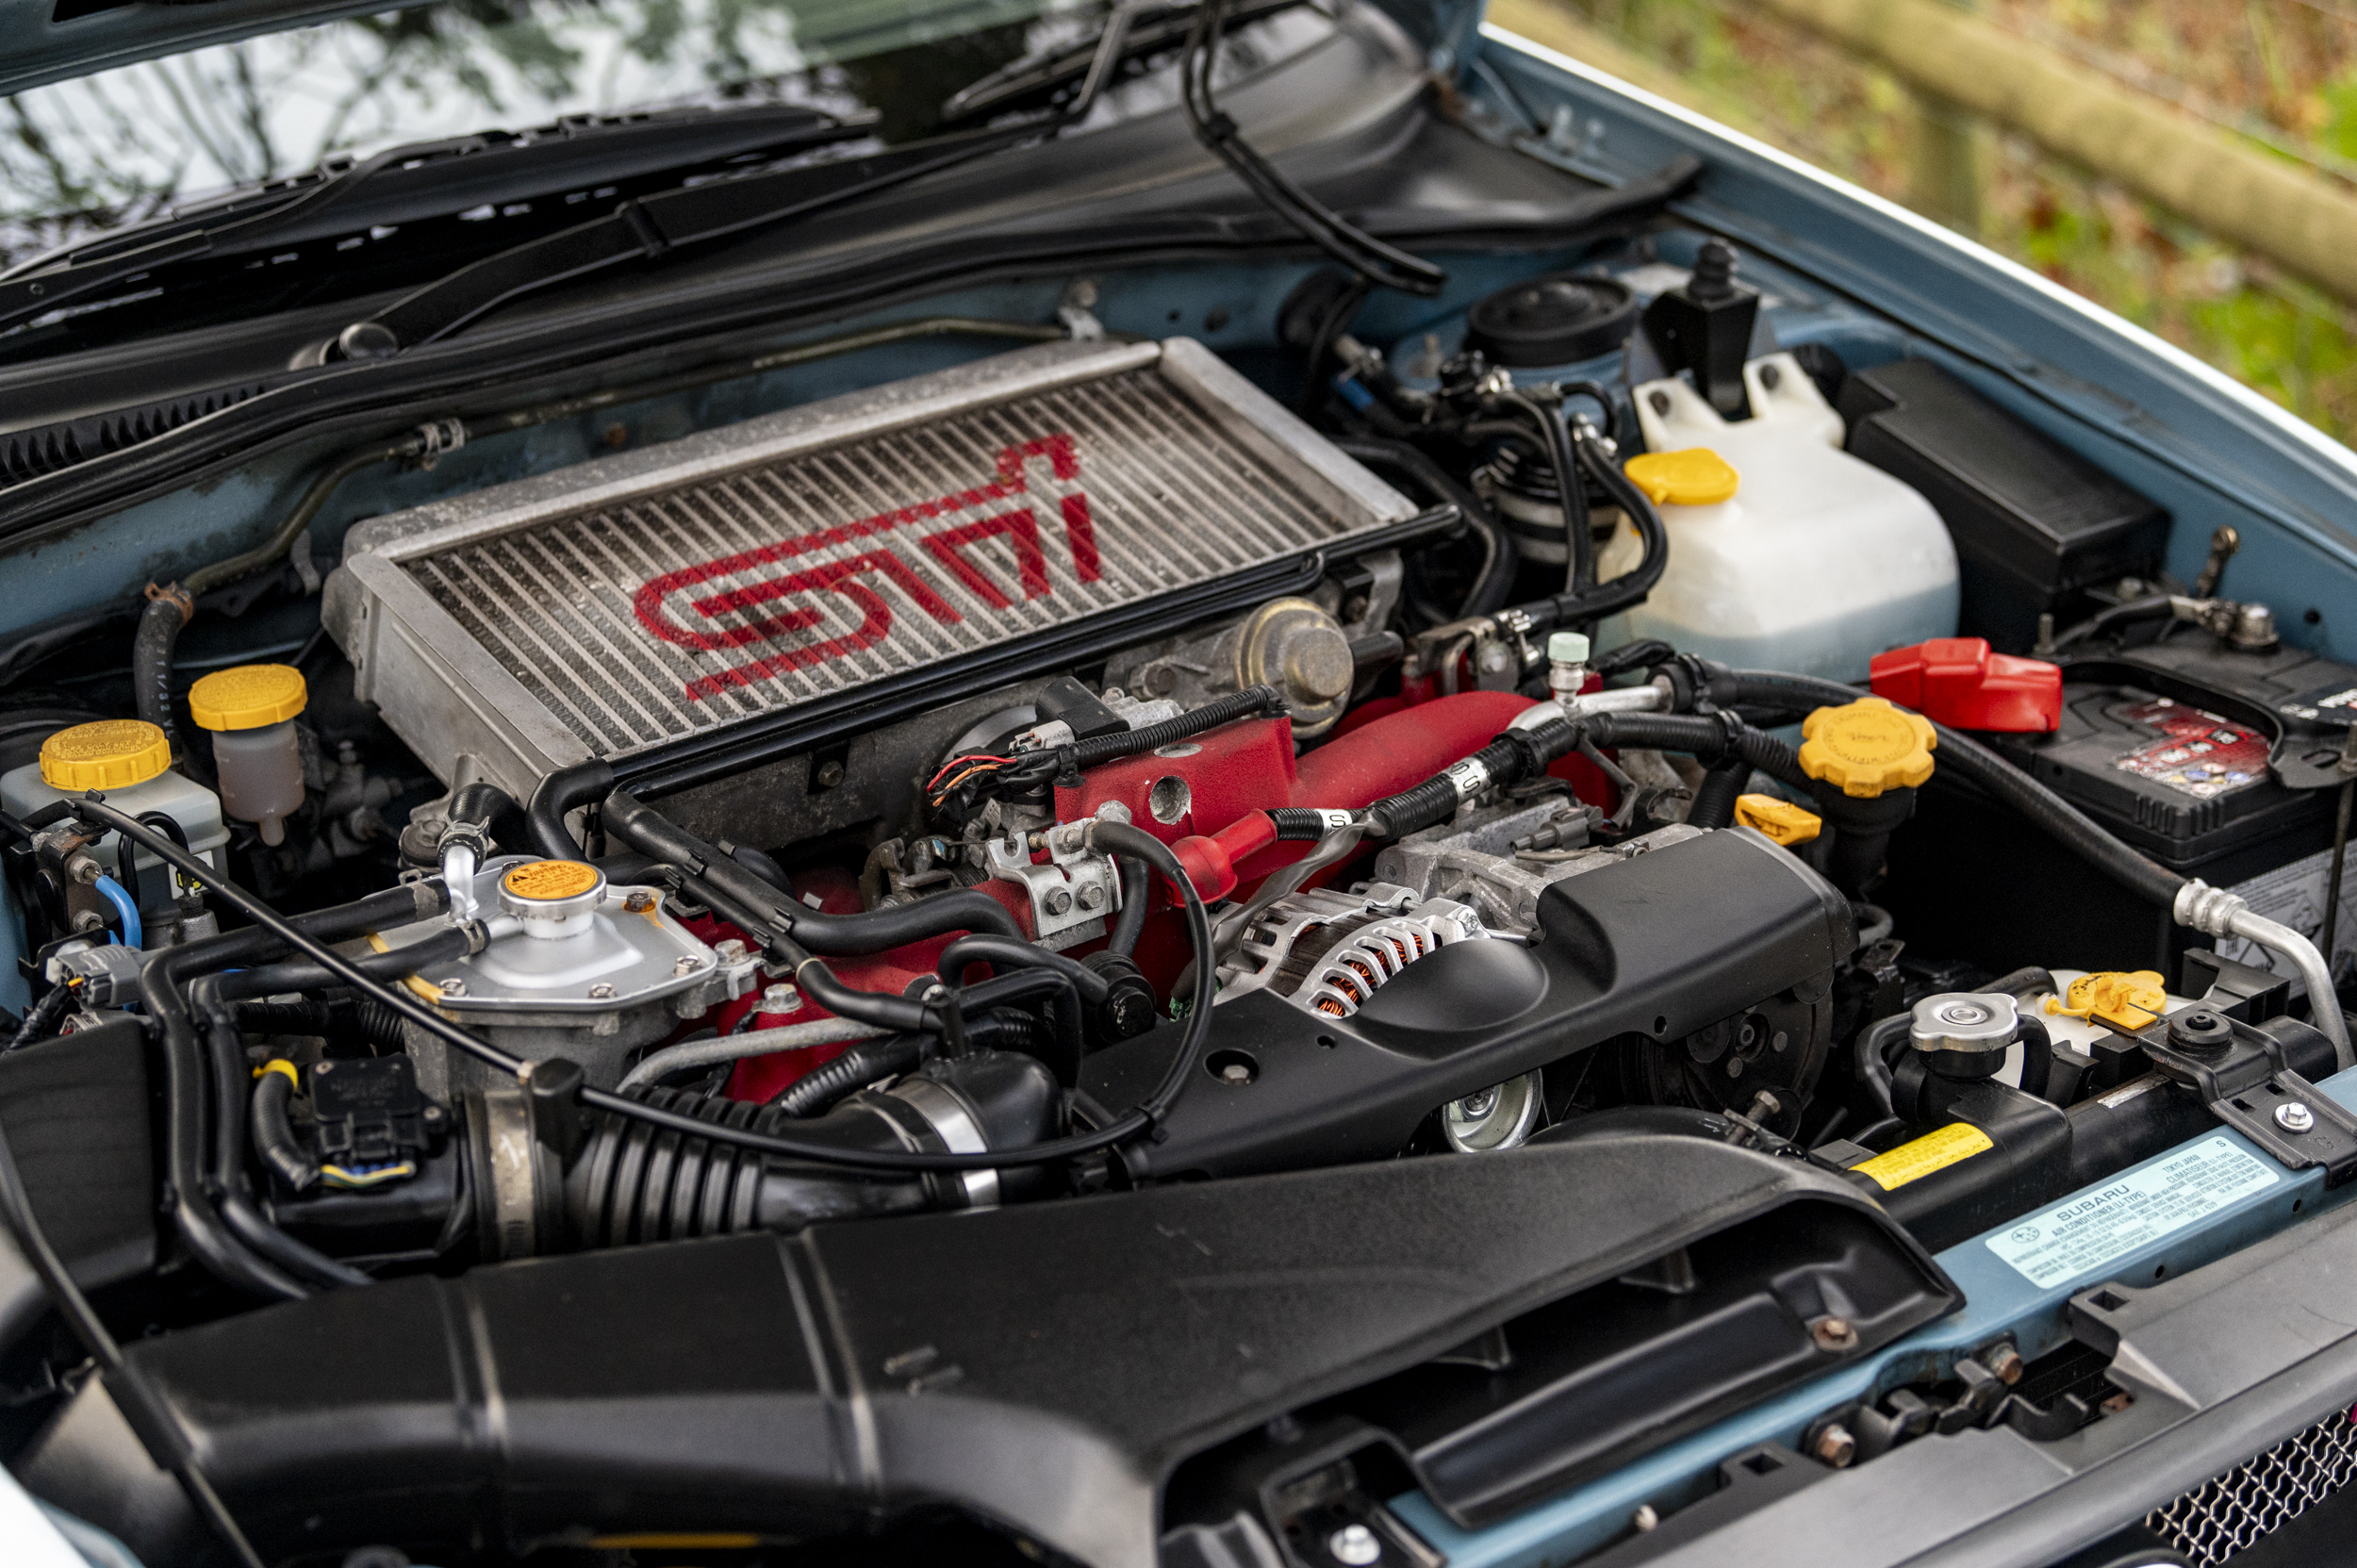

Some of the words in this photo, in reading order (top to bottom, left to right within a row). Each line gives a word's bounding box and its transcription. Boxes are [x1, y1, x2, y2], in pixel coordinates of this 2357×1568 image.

[1463, 775, 1480, 793] S
[1329, 815, 1346, 828] S
[2162, 1162, 2184, 1172] TOKYO
[2180, 1154, 2200, 1164] JAPAN
[2165, 1161, 2210, 1182] CLIMATISEUR
[2055, 1184, 2130, 1221] SUBARU
[2050, 1227, 2067, 1236] AIR
[2064, 1205, 2115, 1230] CONDITIONER
